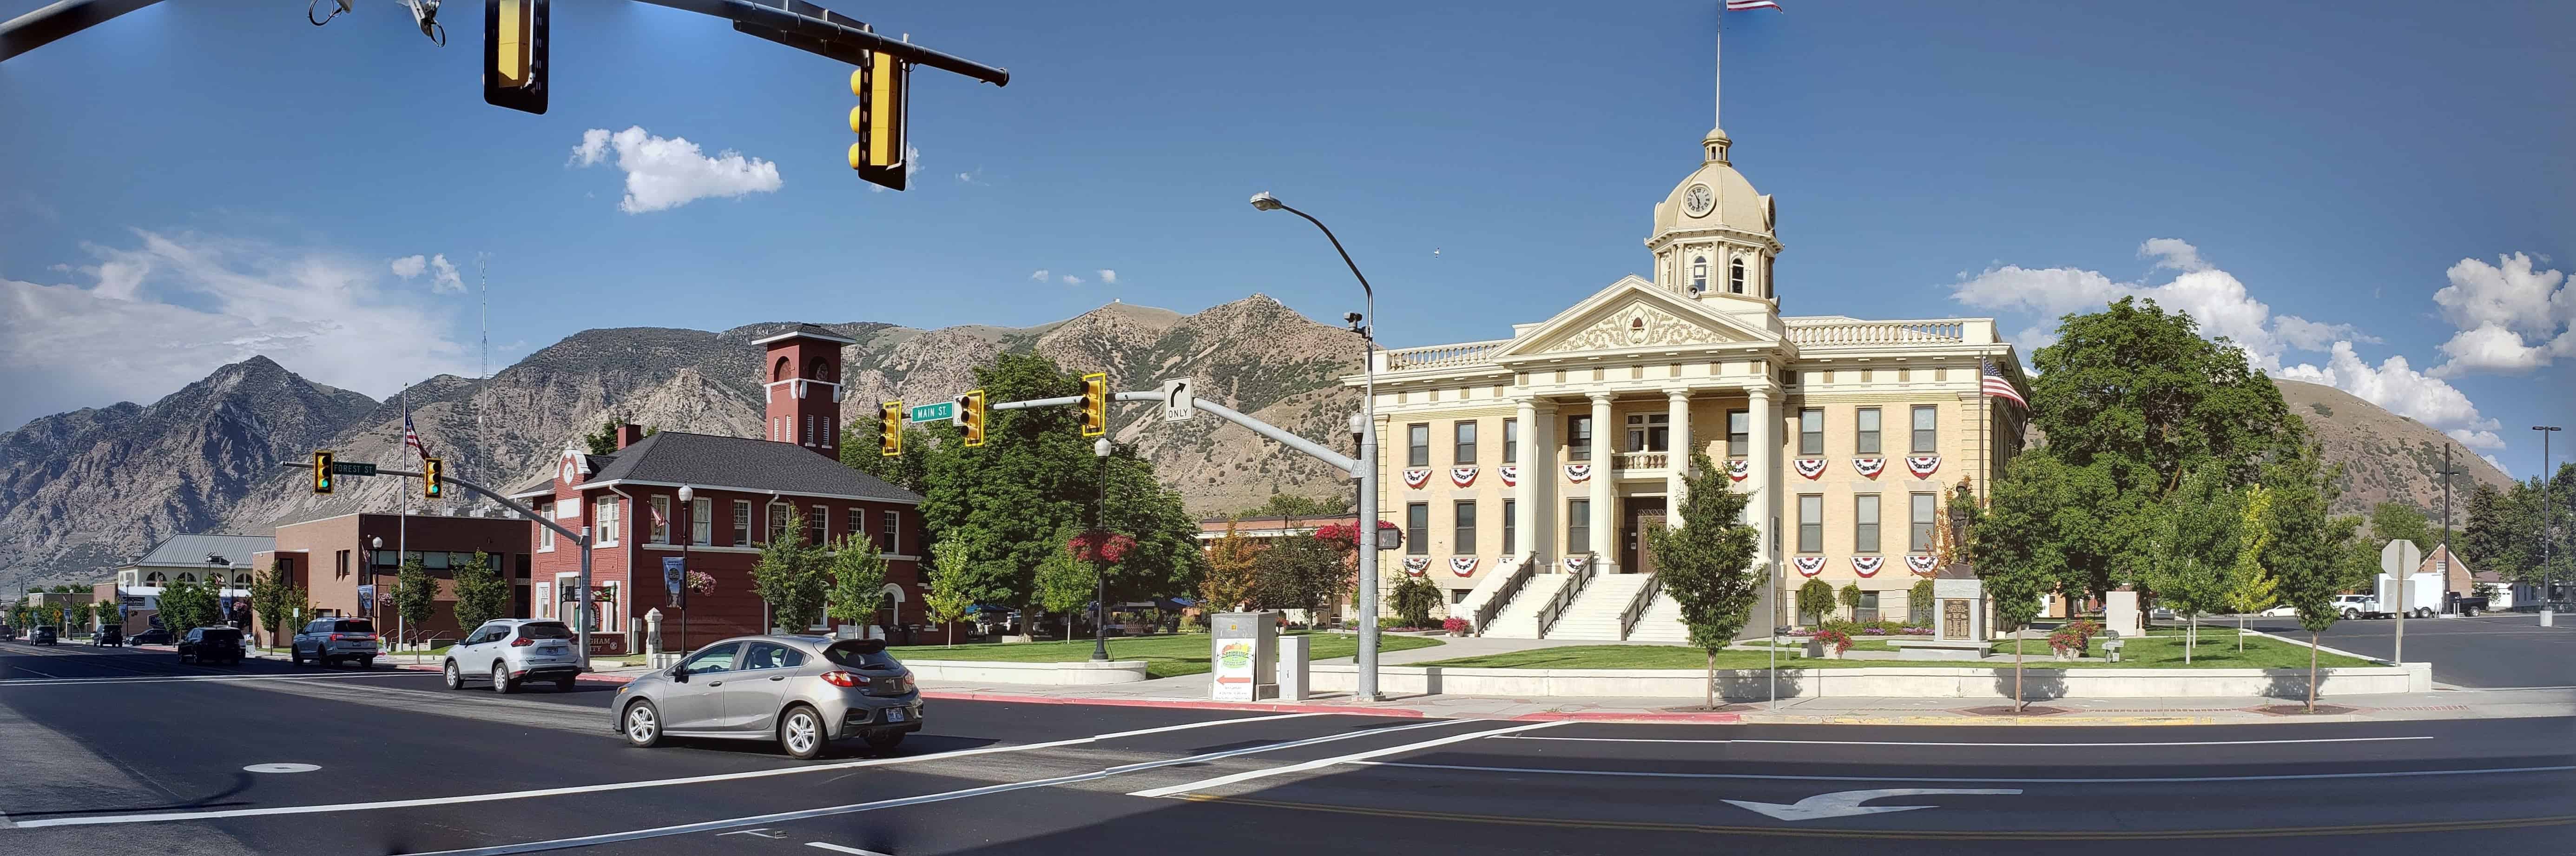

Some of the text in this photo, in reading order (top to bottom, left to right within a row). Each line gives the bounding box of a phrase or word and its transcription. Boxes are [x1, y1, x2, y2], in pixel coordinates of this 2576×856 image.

[918, 406, 947, 418] MAIN ST.
[1168, 408, 1188, 418] ONLY
[334, 464, 361, 473] FOREST
